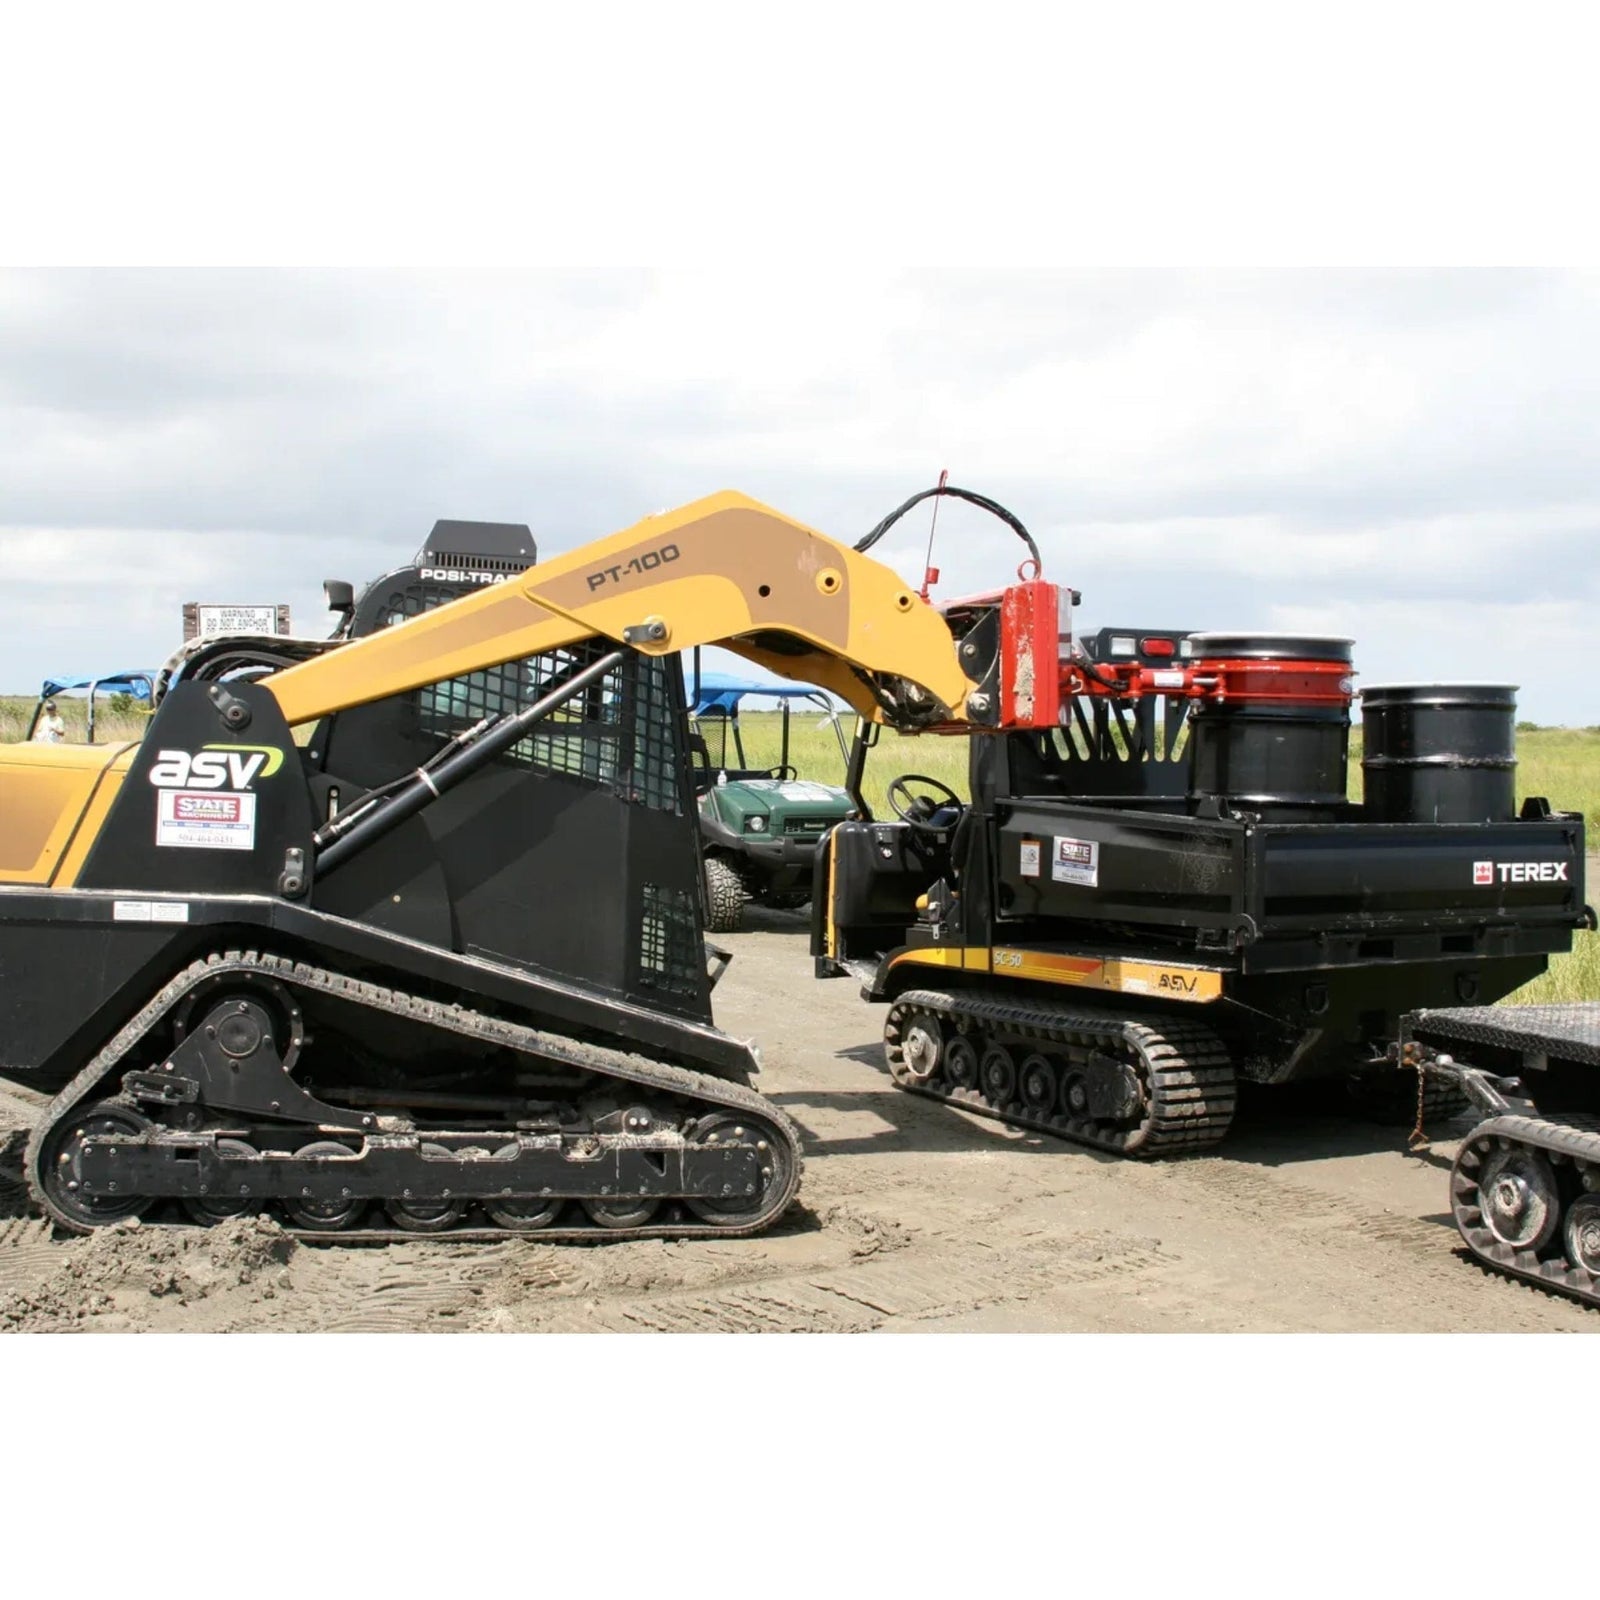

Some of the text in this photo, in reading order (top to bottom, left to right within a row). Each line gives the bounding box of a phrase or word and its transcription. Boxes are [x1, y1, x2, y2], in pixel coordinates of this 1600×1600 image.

[586, 544, 681, 592] PT-100
[220, 609, 256, 618] WARNING
[206, 618, 268, 627] DO NOT ANCHOR
[176, 797, 238, 815] STATE
[176, 811, 237, 821] MACHINERY
[1062, 843, 1090, 857] STATE
[1496, 862, 1568, 882] TEREX
